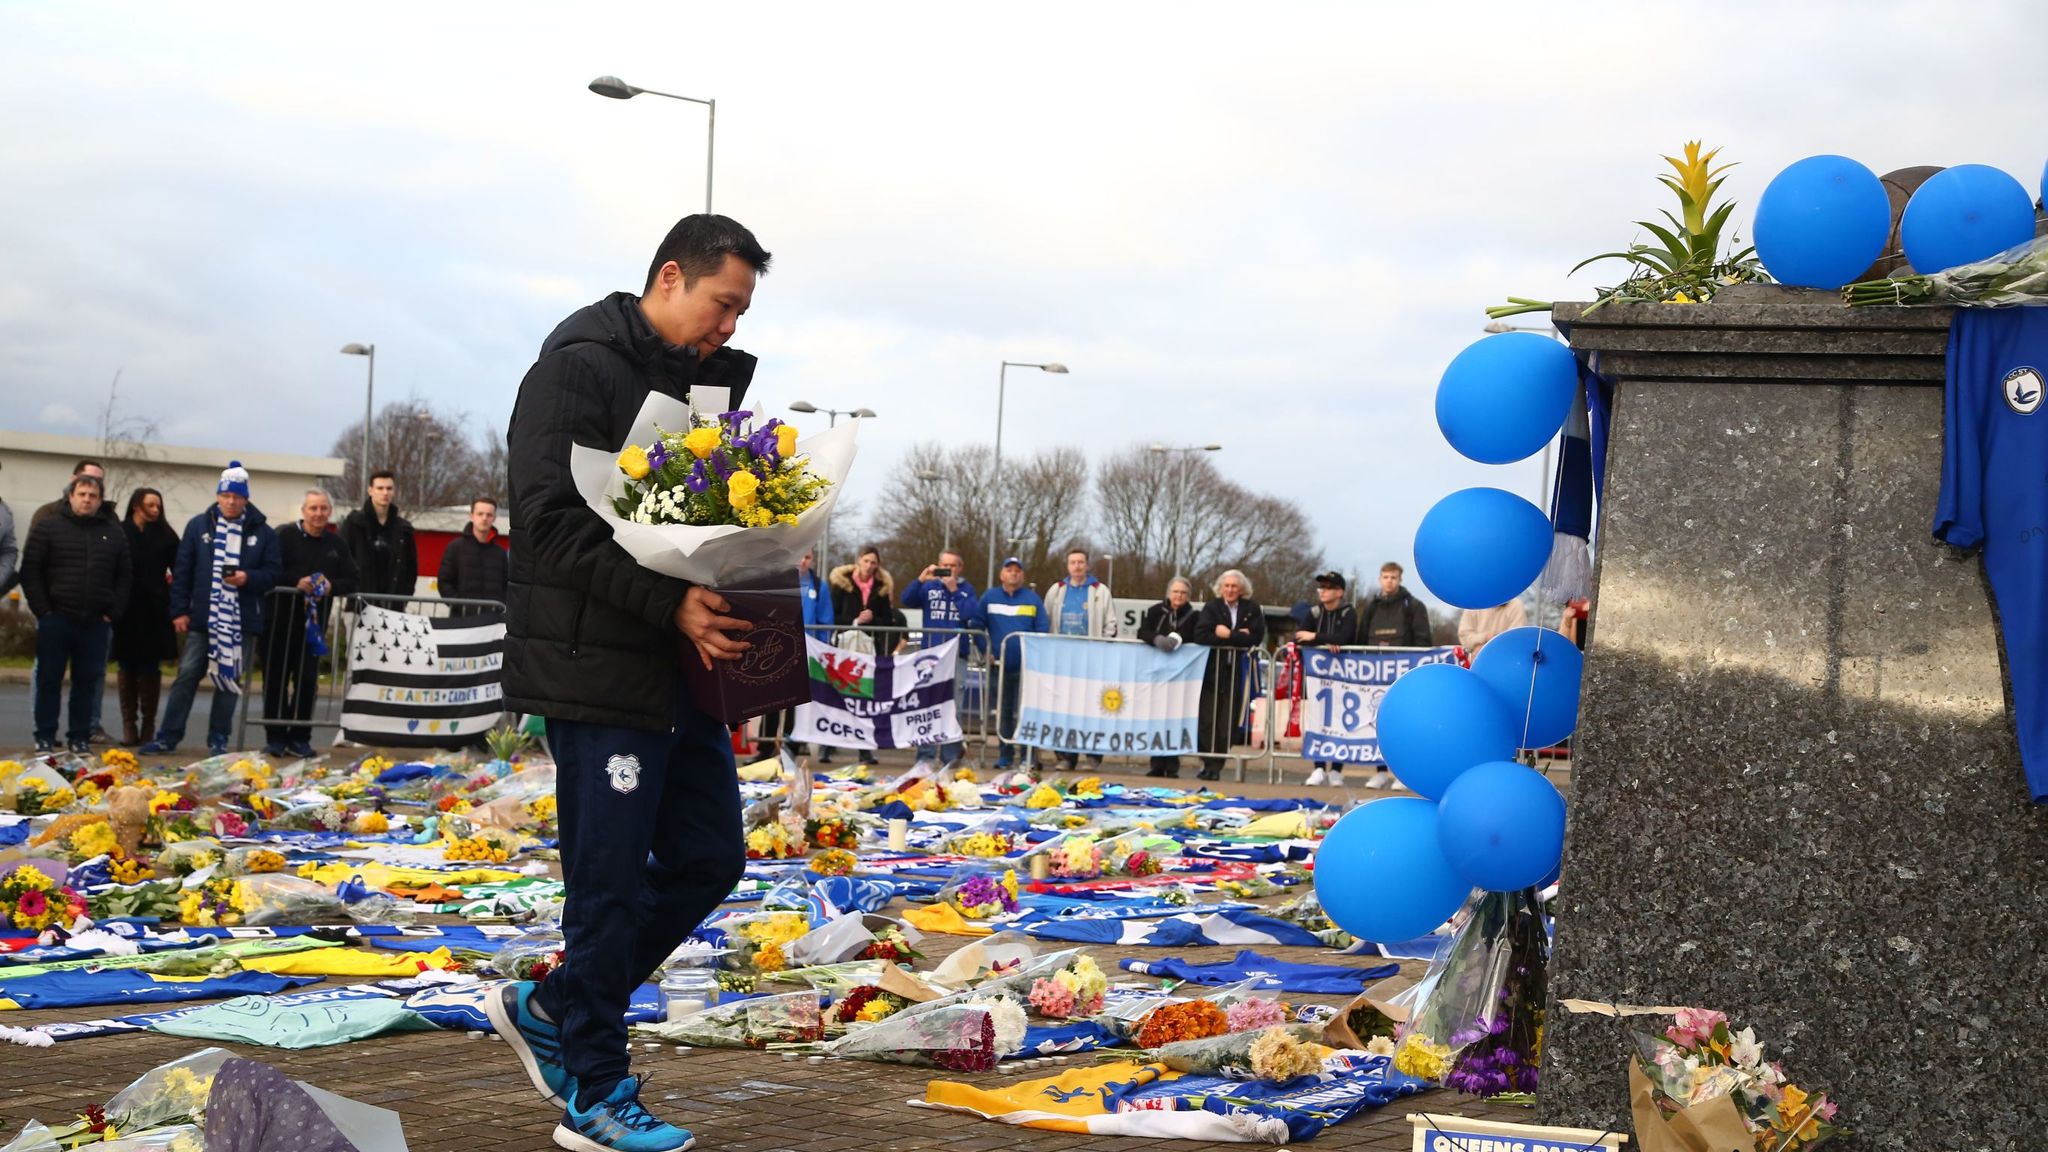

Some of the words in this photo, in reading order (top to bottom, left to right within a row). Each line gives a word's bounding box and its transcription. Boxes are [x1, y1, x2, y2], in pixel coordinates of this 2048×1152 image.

[1311, 653, 1409, 682] CARDIFF
[843, 697, 895, 716] CLUB
[897, 692, 920, 711] 44
[906, 708, 942, 726] PRIDE
[816, 717, 866, 741] CCFC
[908, 732, 949, 748] WALES
[917, 724, 933, 736] OF
[1308, 739, 1385, 762] FOOTBA
